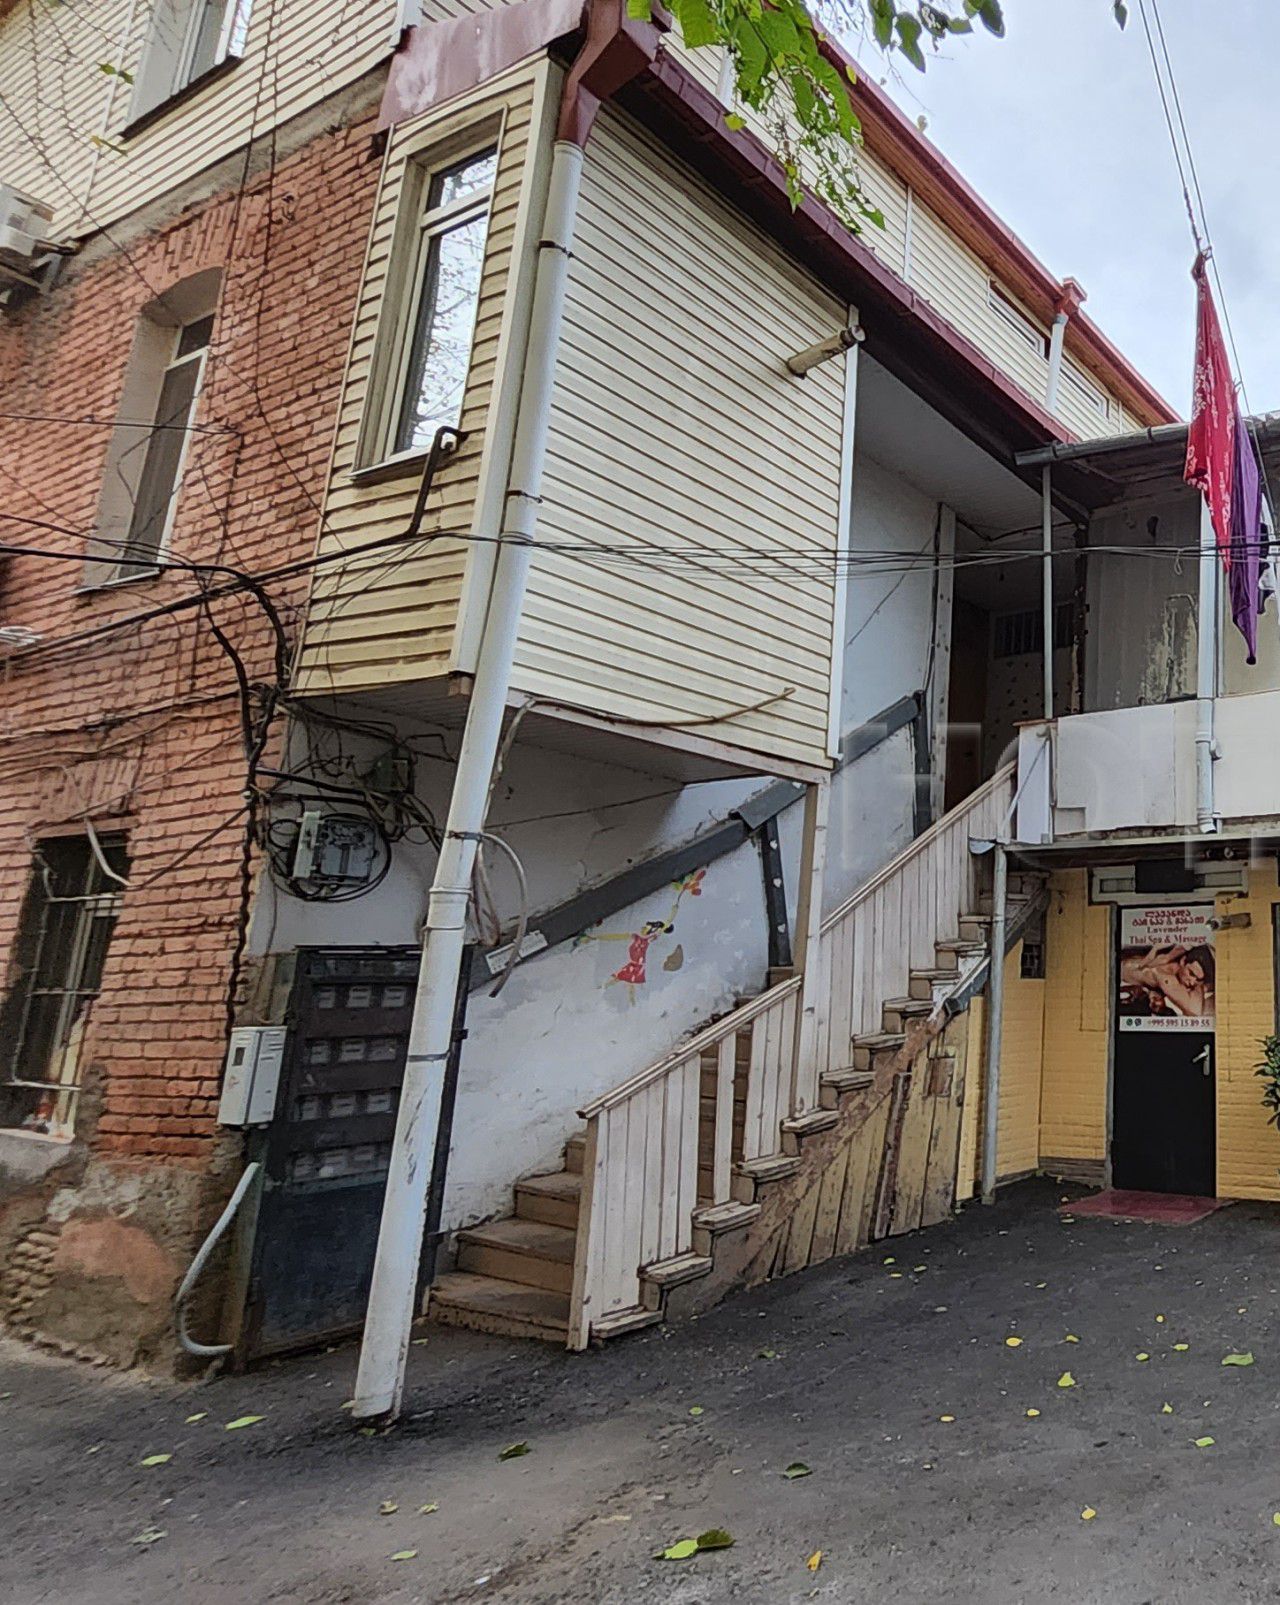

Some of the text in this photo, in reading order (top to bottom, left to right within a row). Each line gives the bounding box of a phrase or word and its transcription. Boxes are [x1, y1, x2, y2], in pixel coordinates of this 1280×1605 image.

[1147, 926, 1188, 934] Lavender
[1129, 934, 1207, 945] Thai Spa & Massage
